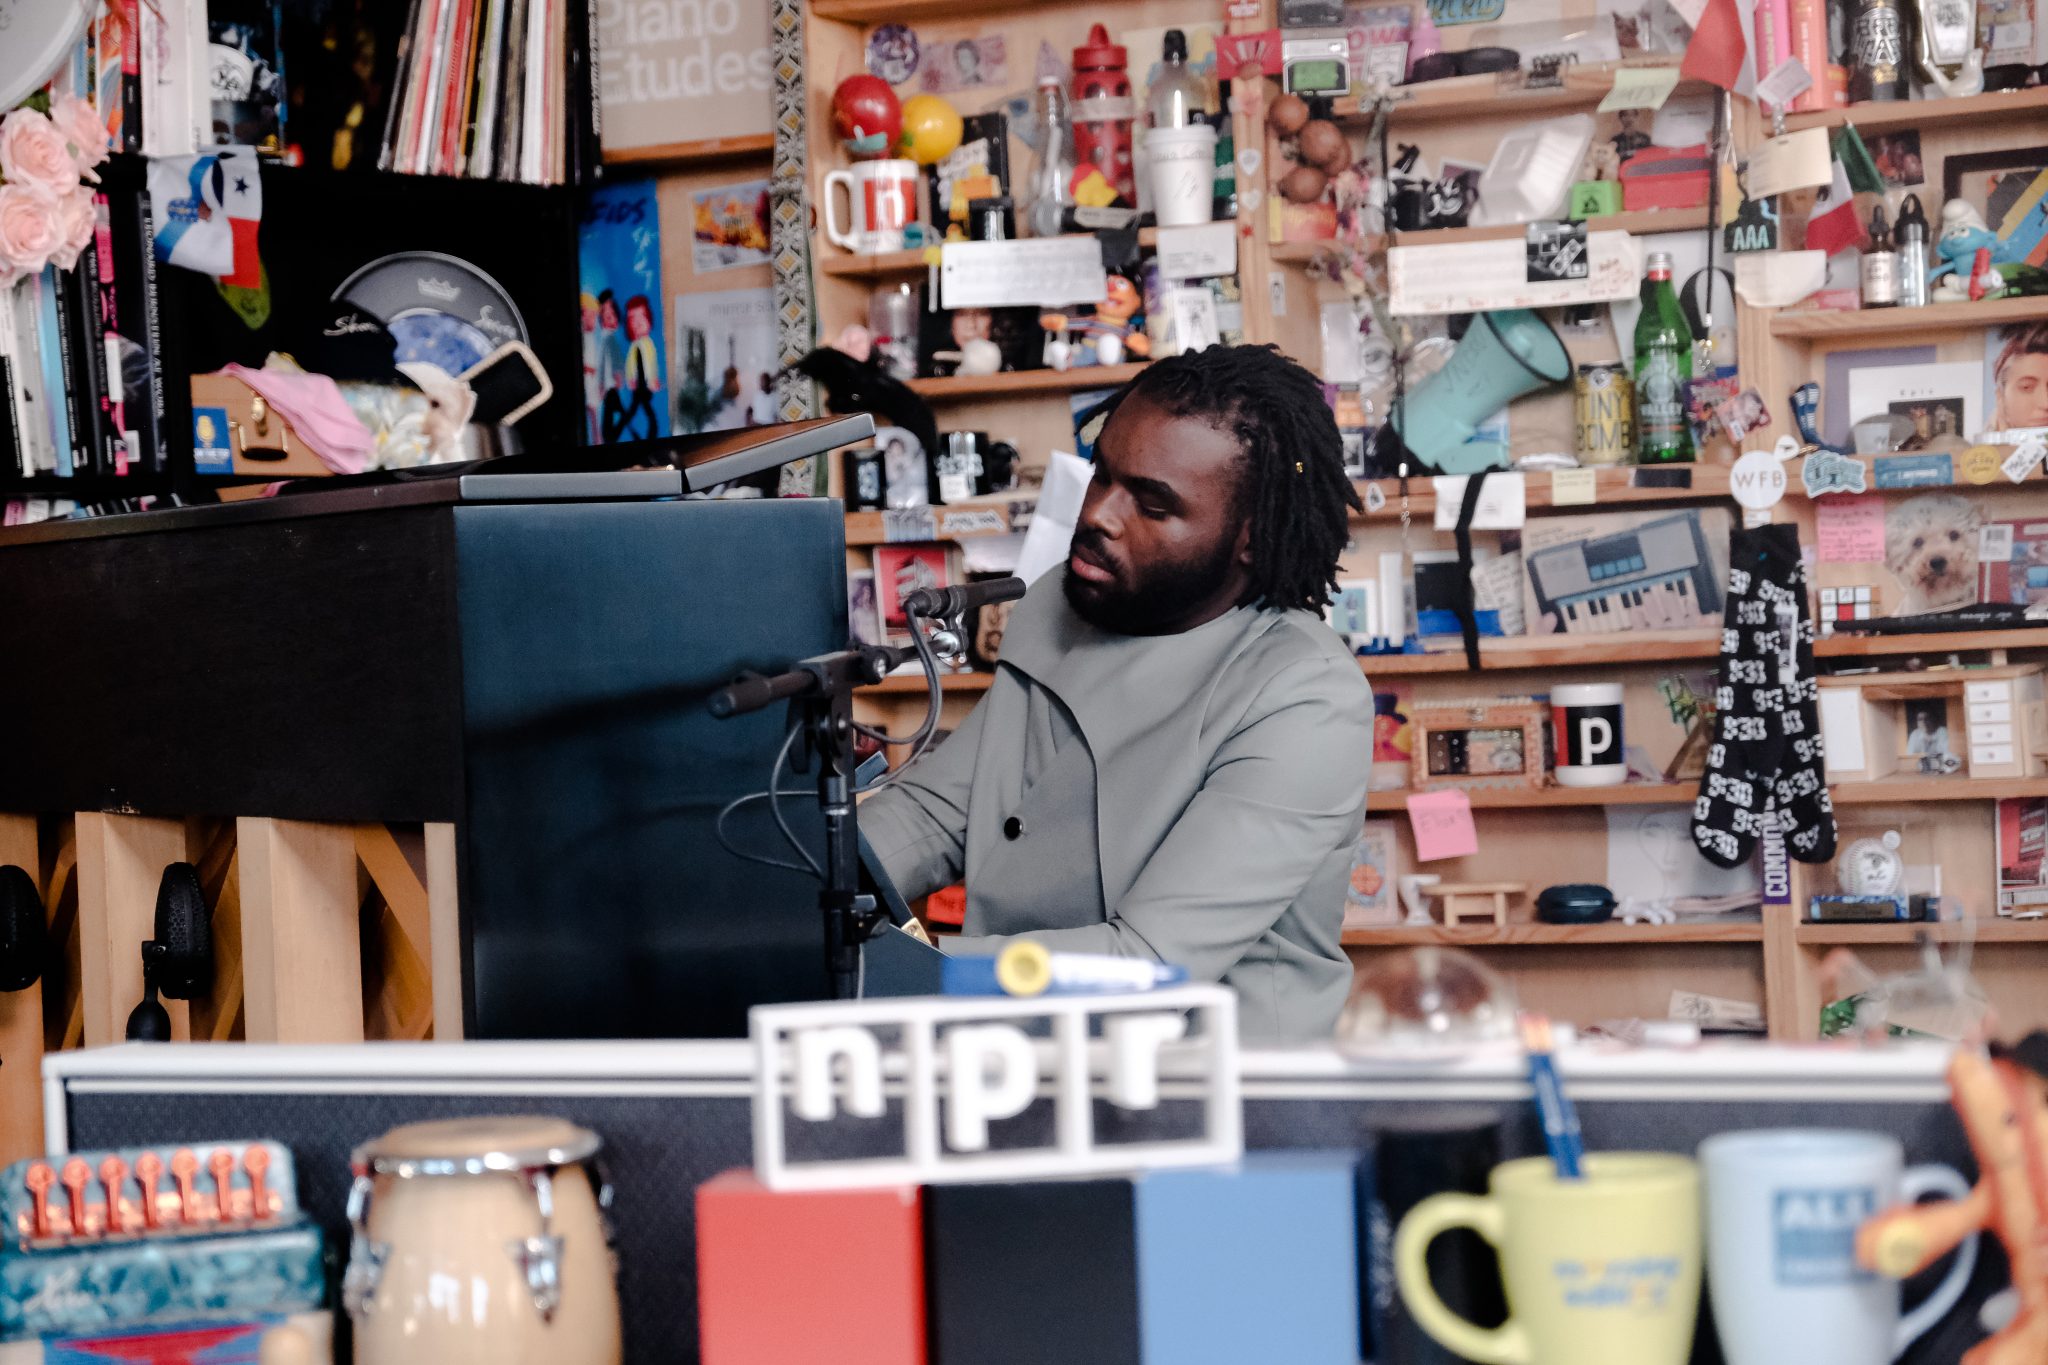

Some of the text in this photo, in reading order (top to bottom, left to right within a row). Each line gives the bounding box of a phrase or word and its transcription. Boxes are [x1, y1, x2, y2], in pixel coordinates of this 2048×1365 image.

[1580, 717, 1612, 766] p
[1723, 715, 1767, 741] 9:30
[1708, 772, 1753, 808] 9:30
[1695, 825, 1739, 860] 9:30
[793, 1012, 1187, 1151] npr
